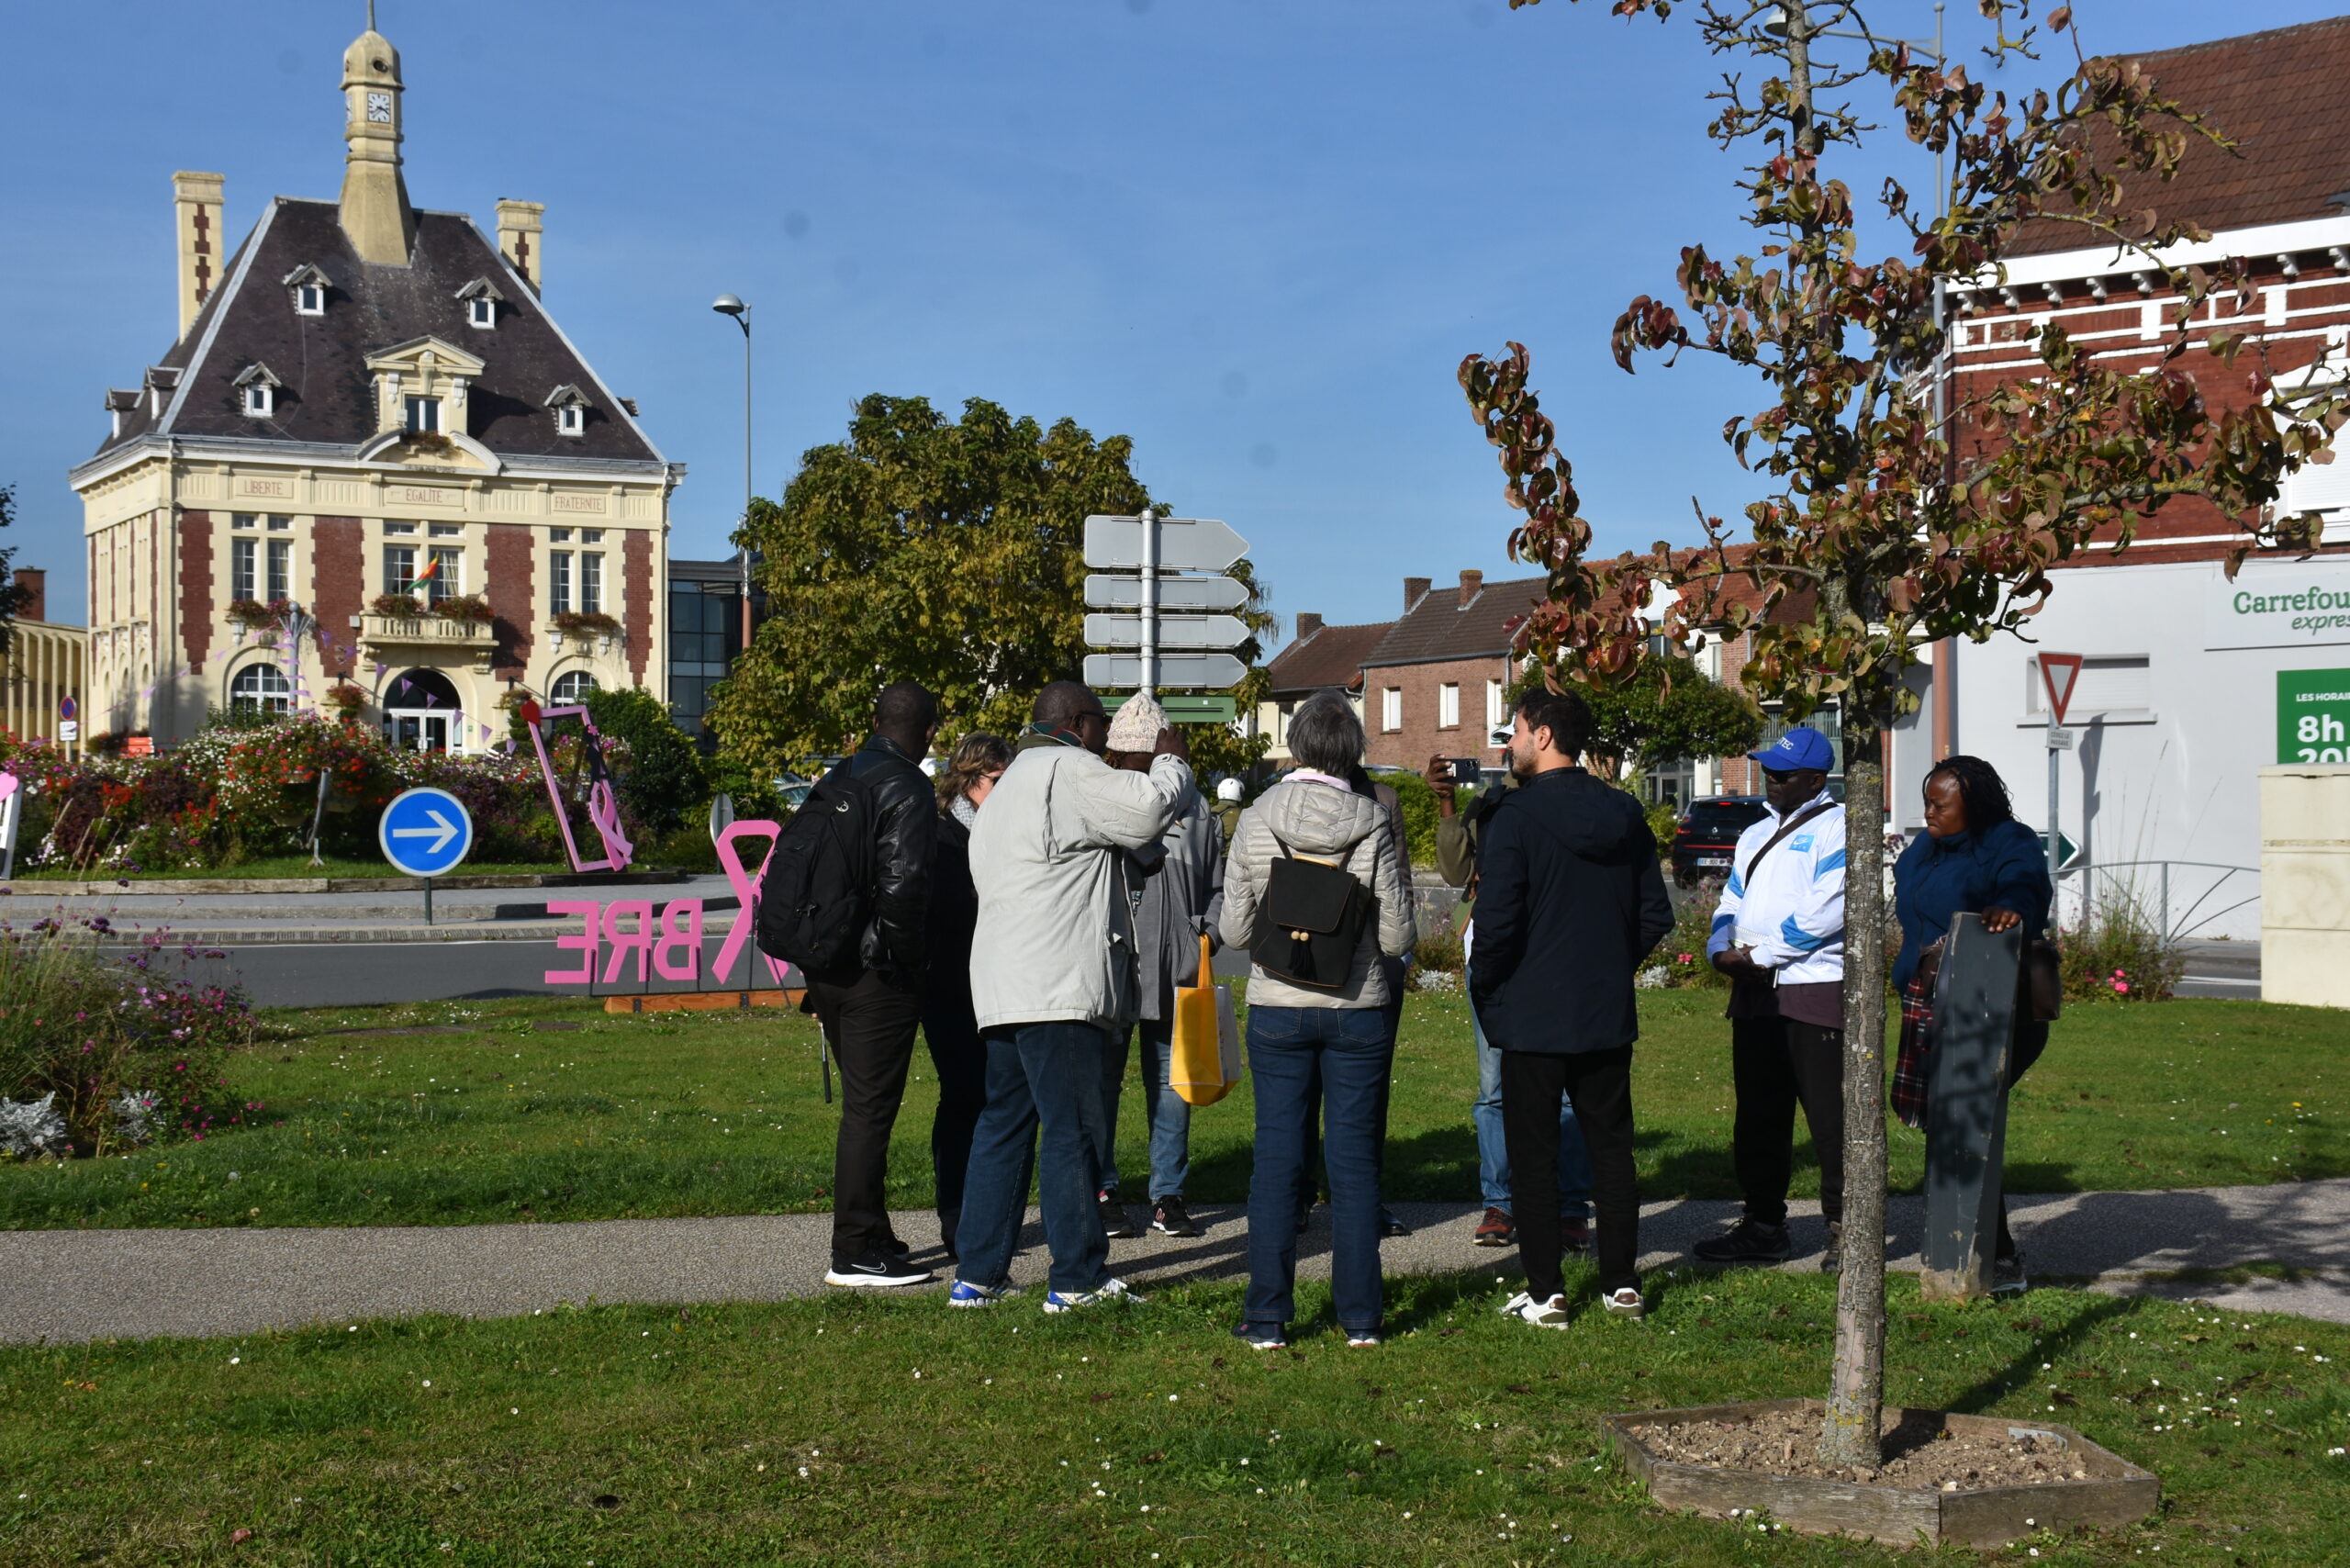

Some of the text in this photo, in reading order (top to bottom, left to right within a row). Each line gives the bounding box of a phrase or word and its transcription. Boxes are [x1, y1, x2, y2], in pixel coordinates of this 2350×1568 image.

[2296, 693, 2313, 702] LES
[2297, 713, 2344, 743] 8h
[2297, 745, 2350, 763] 20
